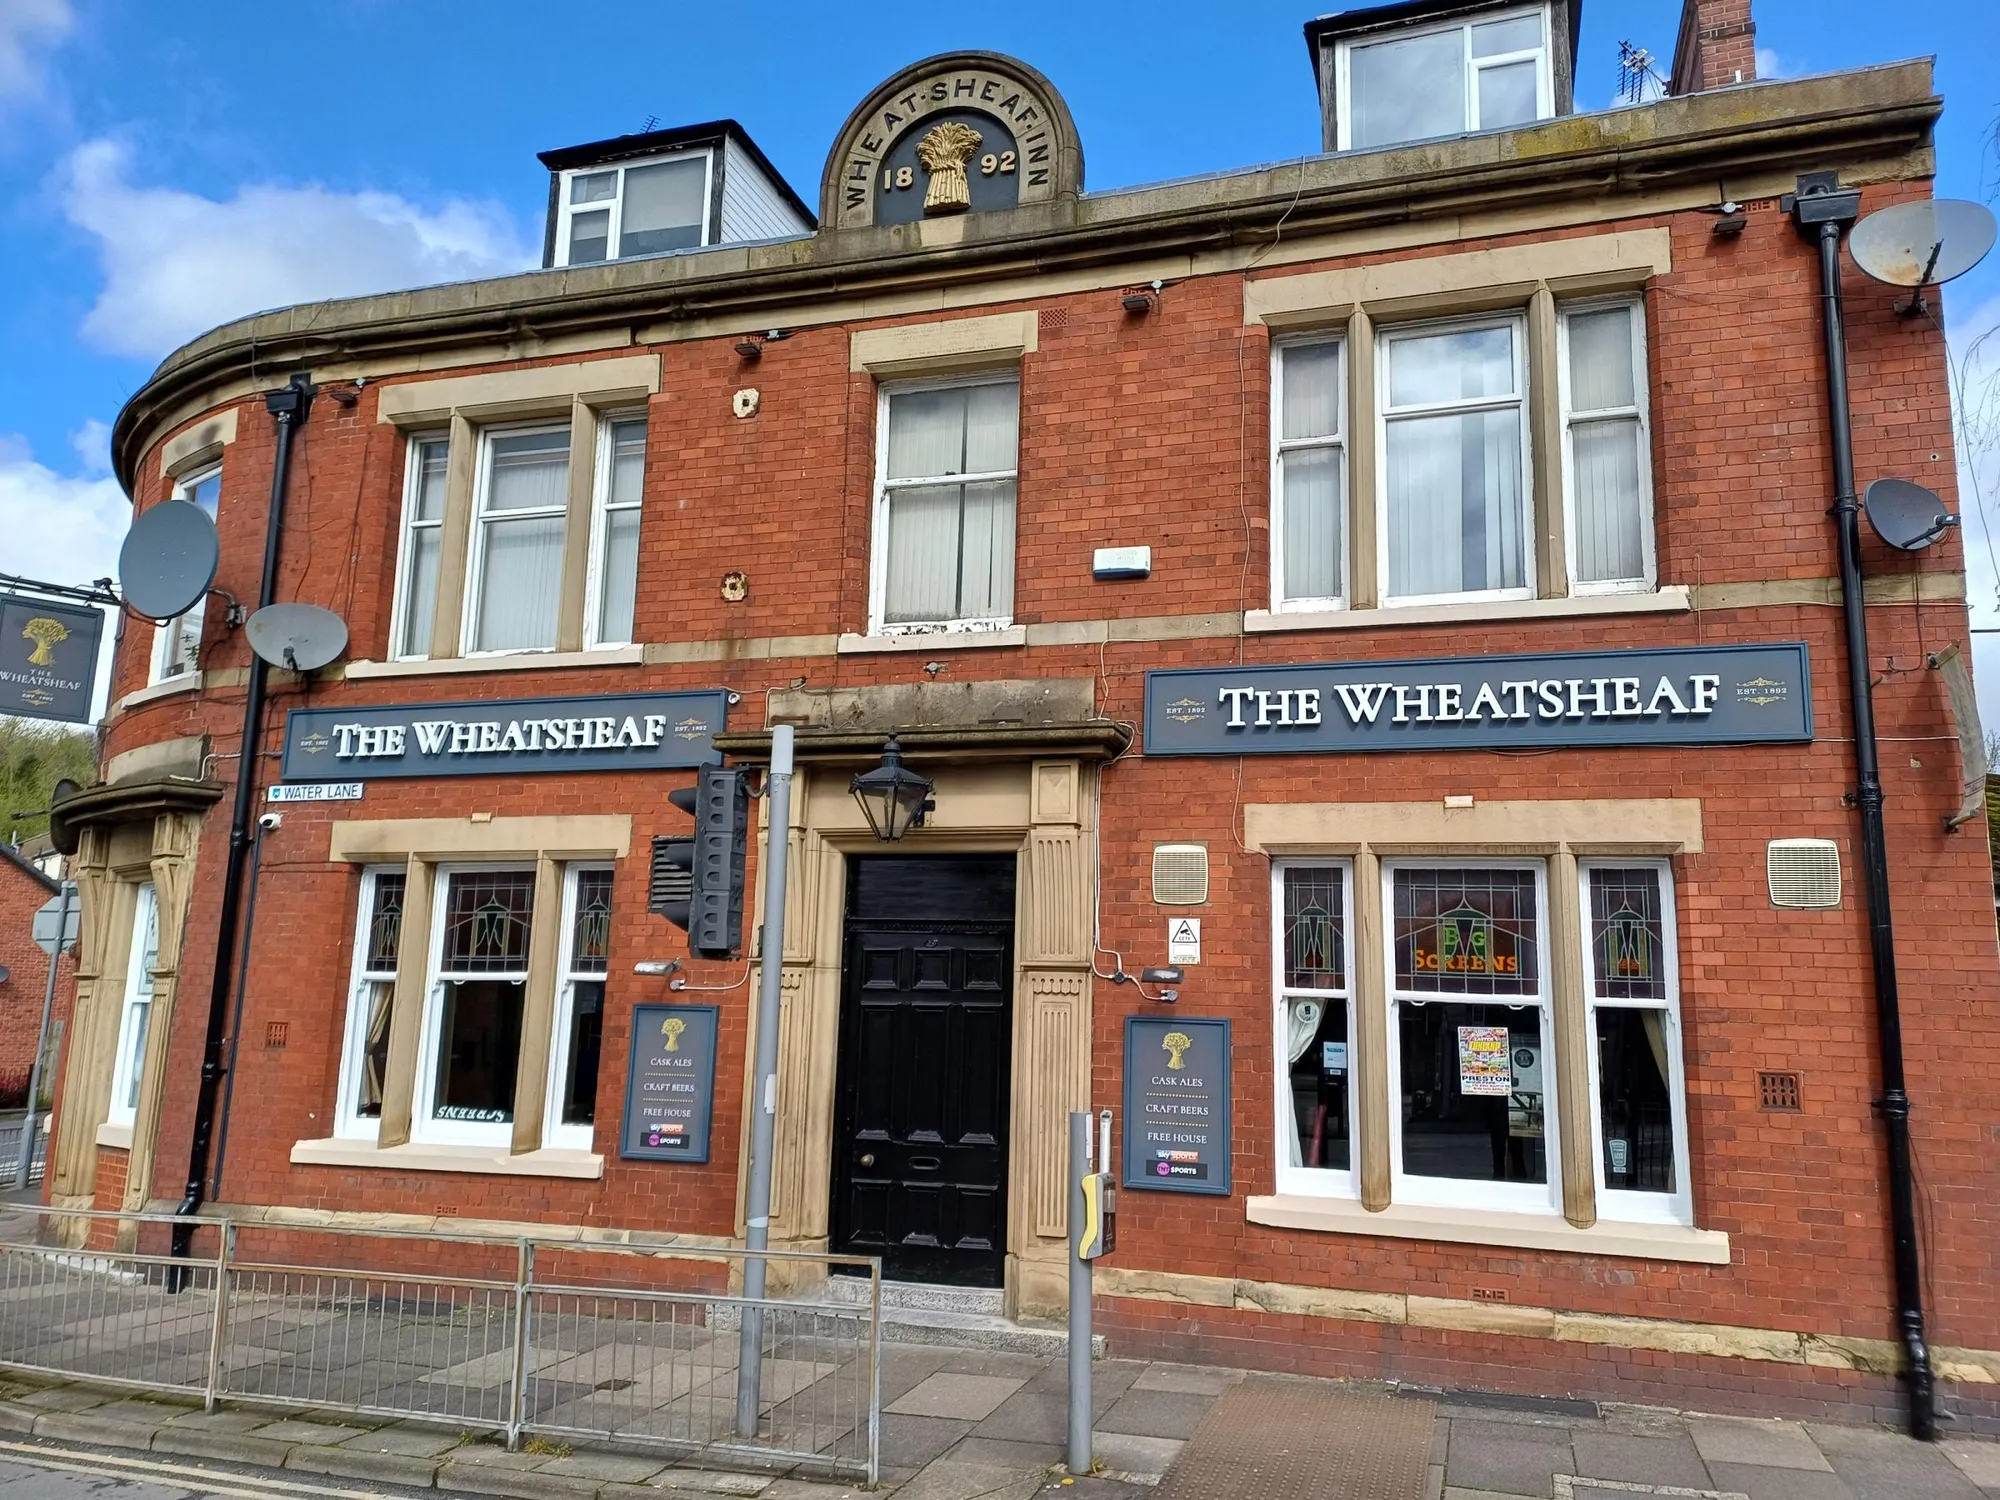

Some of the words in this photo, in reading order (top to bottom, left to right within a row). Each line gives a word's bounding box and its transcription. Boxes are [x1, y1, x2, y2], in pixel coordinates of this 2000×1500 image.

[1026, 131, 1049, 188] INN
[30, 668, 52, 677] THE
[0, 670, 81, 690] WHEATSHEAF
[1218, 684, 1322, 728] THE
[1334, 674, 1721, 723] WHEATSHEAF
[332, 723, 406, 758] THE
[411, 714, 667, 755] WHEATSHEAF
[284, 785, 323, 800] WATER
[327, 784, 359, 798] LANE
[1415, 949, 1517, 972] SCREENS
[650, 1057, 671, 1066] CASK
[672, 1058, 692, 1067] ALES
[1151, 1076, 1178, 1086] CASK
[1179, 1077, 1203, 1087] ALES
[643, 1083, 670, 1092] CRAFT
[671, 1083, 695, 1093] BEERS
[643, 1108, 662, 1116] FREE
[663, 1109, 691, 1118] HOUSE
[1145, 1104, 1178, 1114] CRAFT
[1180, 1106, 1209, 1116] BEERS
[660, 1137, 681, 1145] SPORTS
[1147, 1132, 1171, 1142] FREE
[1173, 1134, 1208, 1144] HOUSE
[1157, 1150, 1170, 1159] sky
[1171, 1151, 1198, 1161] sports
[1170, 1166, 1197, 1175] SPORTS
